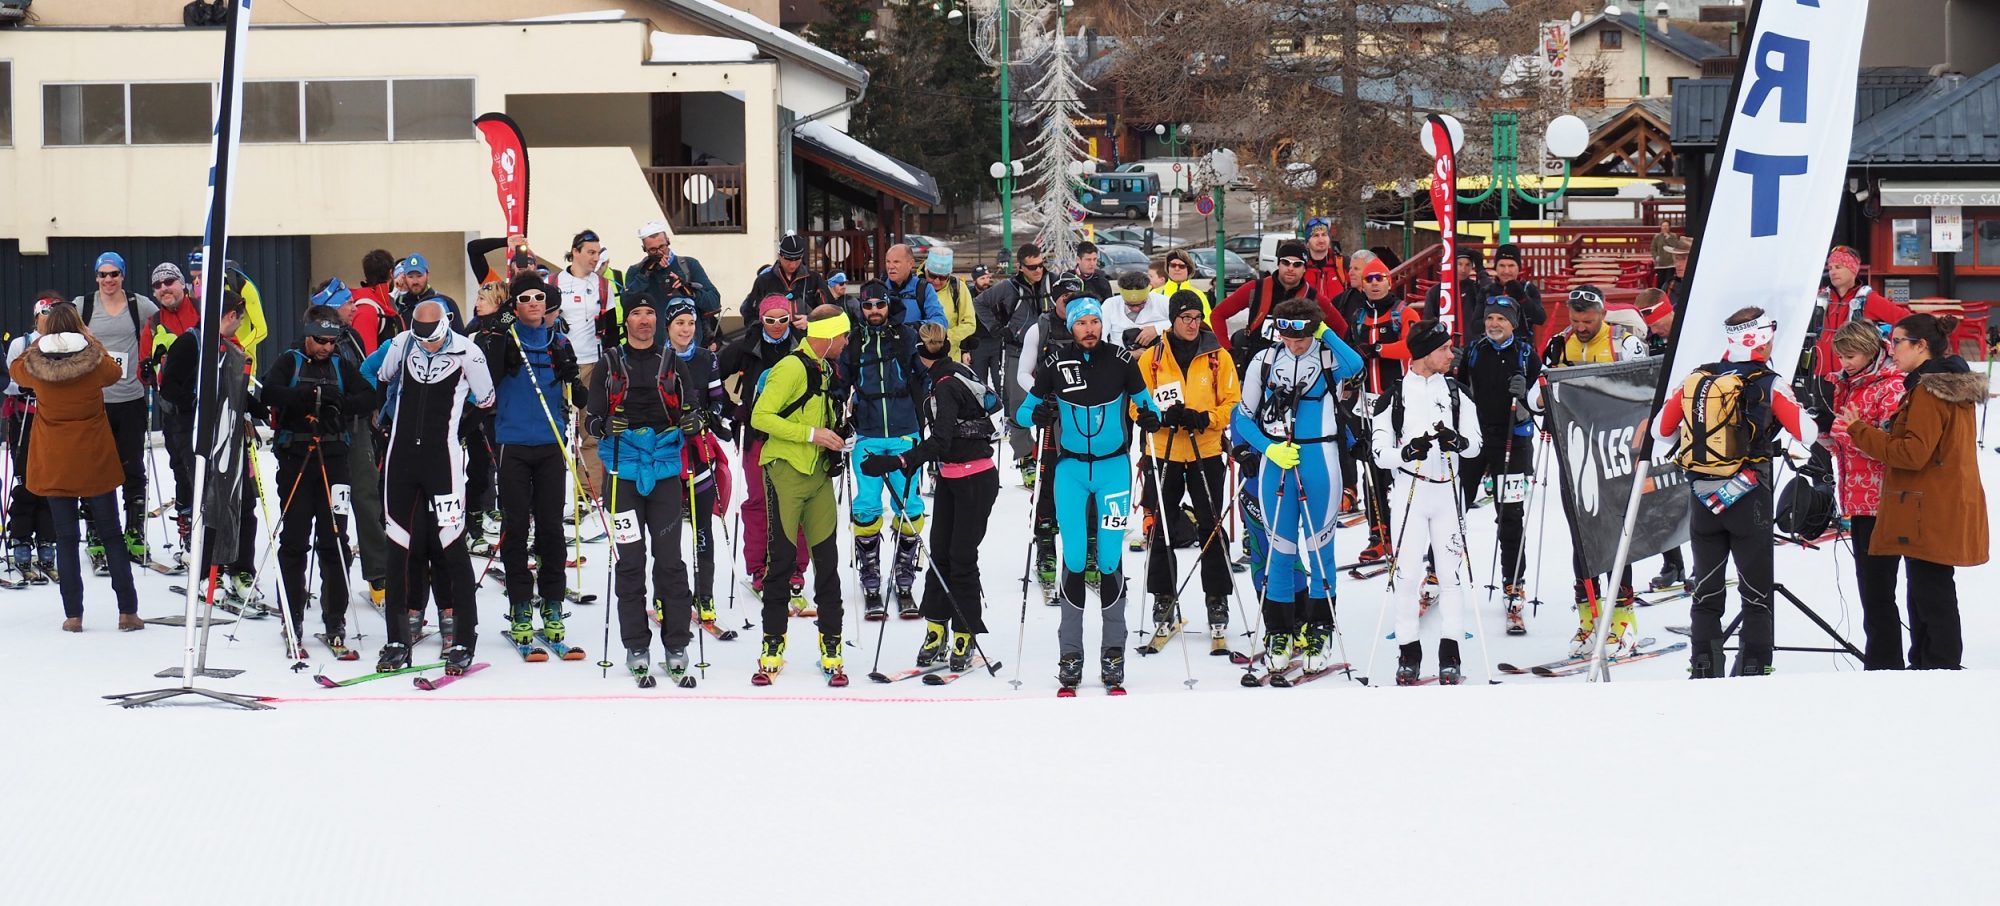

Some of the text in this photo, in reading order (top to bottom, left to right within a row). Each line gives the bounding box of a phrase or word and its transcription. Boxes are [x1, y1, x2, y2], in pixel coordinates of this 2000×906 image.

[1150, 197, 1157, 206] P
[1913, 192, 1964, 206] CRÊPES
[1155, 388, 1178, 403] 125
[1697, 380, 1713, 423] DYNASTAR
[1598, 425, 1635, 480] LES
[435, 498, 461, 512] 171
[614, 518, 632, 530] 53
[1103, 515, 1128, 528] 154
